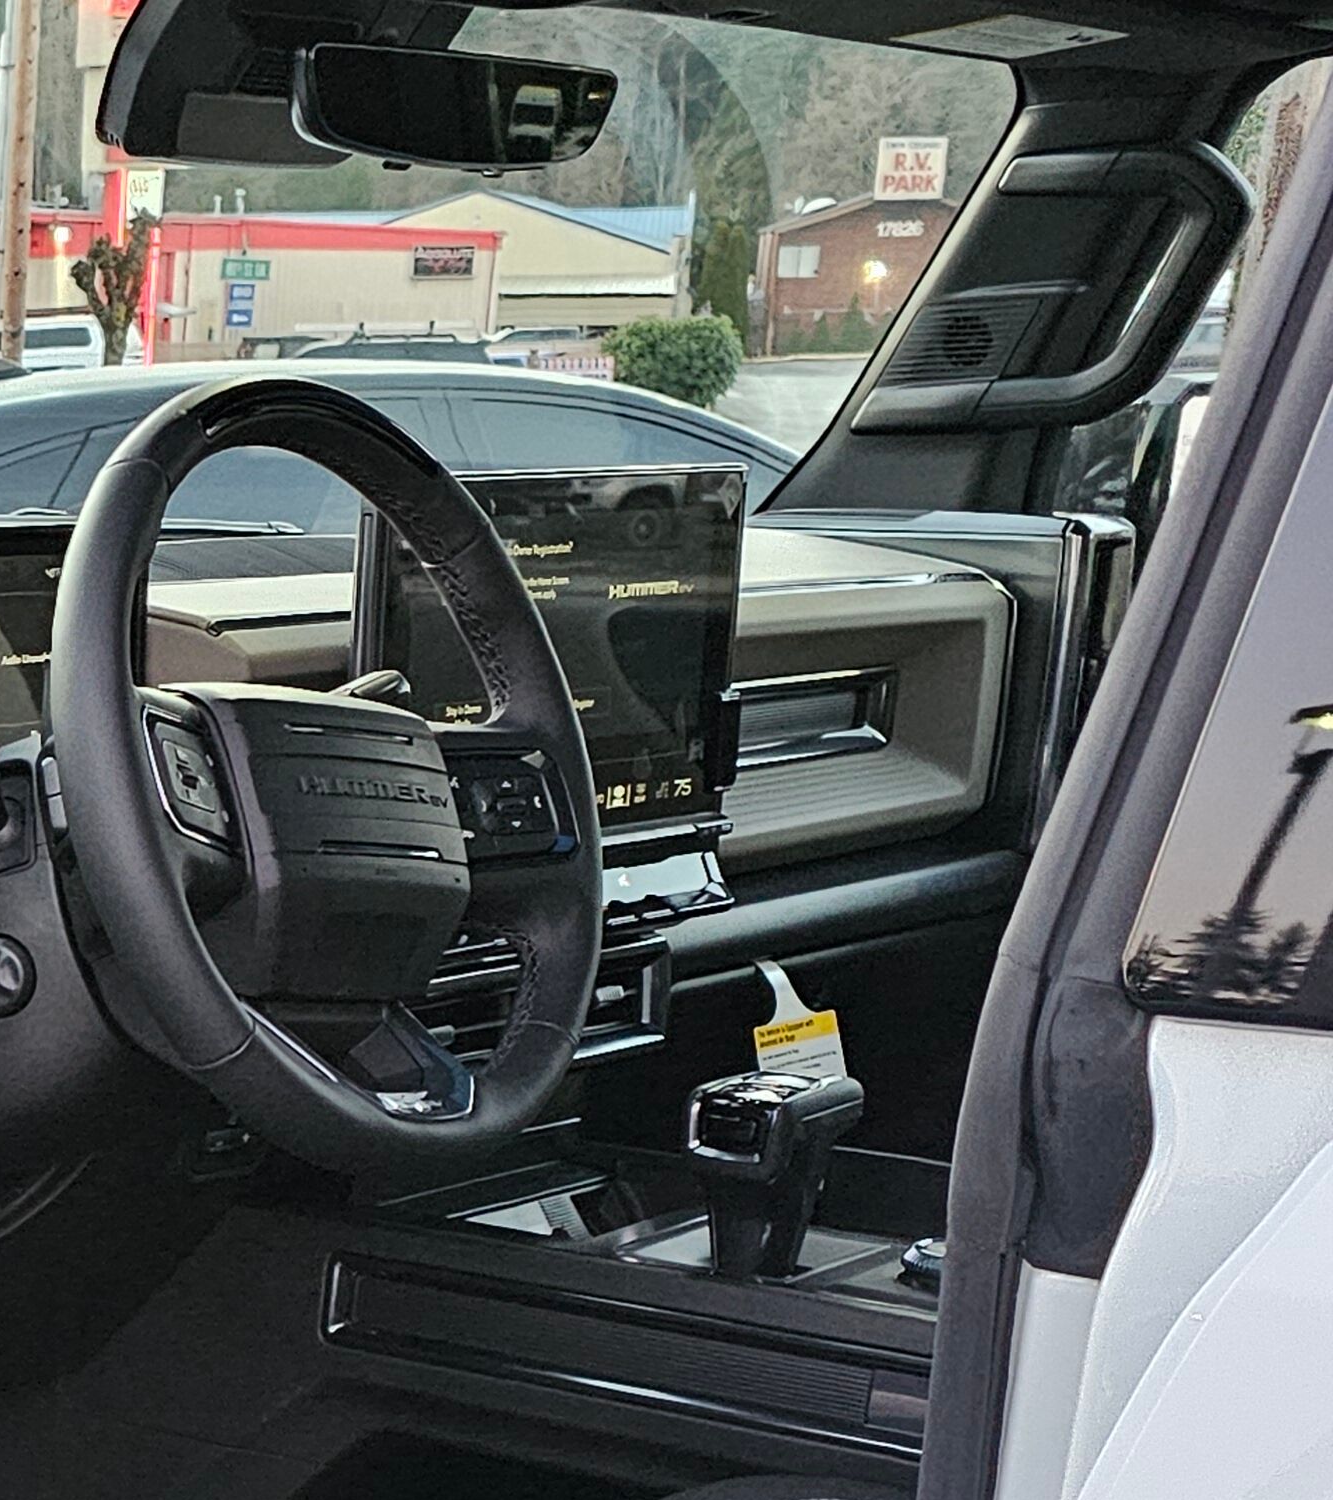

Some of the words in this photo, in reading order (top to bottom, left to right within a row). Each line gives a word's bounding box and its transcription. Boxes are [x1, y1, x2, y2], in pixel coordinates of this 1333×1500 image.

[894, 152, 932, 172] R.V.
[881, 174, 939, 193] PARK
[299, 775, 430, 804] HUMMER
[674, 778, 692, 797] 75
